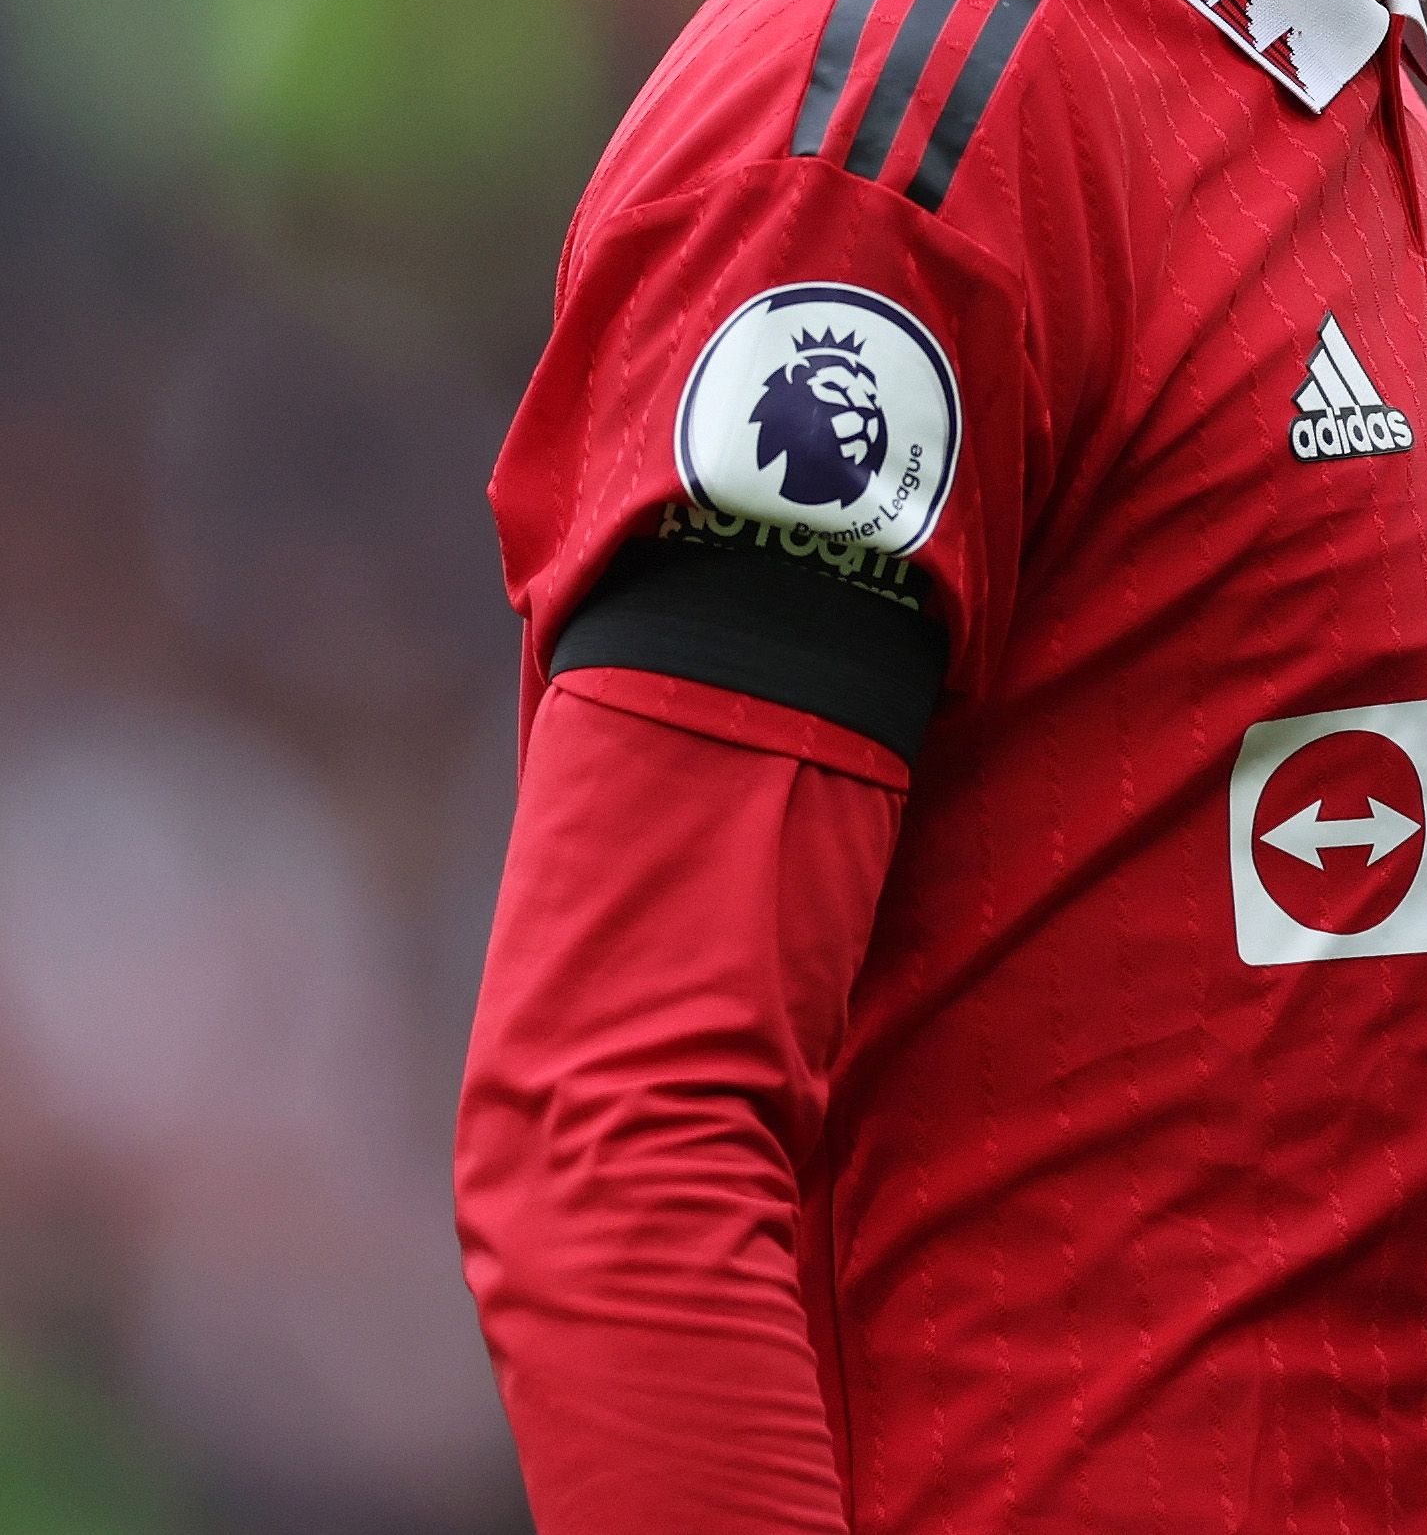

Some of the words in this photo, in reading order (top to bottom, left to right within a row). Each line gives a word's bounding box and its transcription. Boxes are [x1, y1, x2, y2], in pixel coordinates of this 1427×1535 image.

[1292, 405, 1412, 458] adidas
[796, 516, 883, 543] Premier
[880, 443, 923, 521] League
